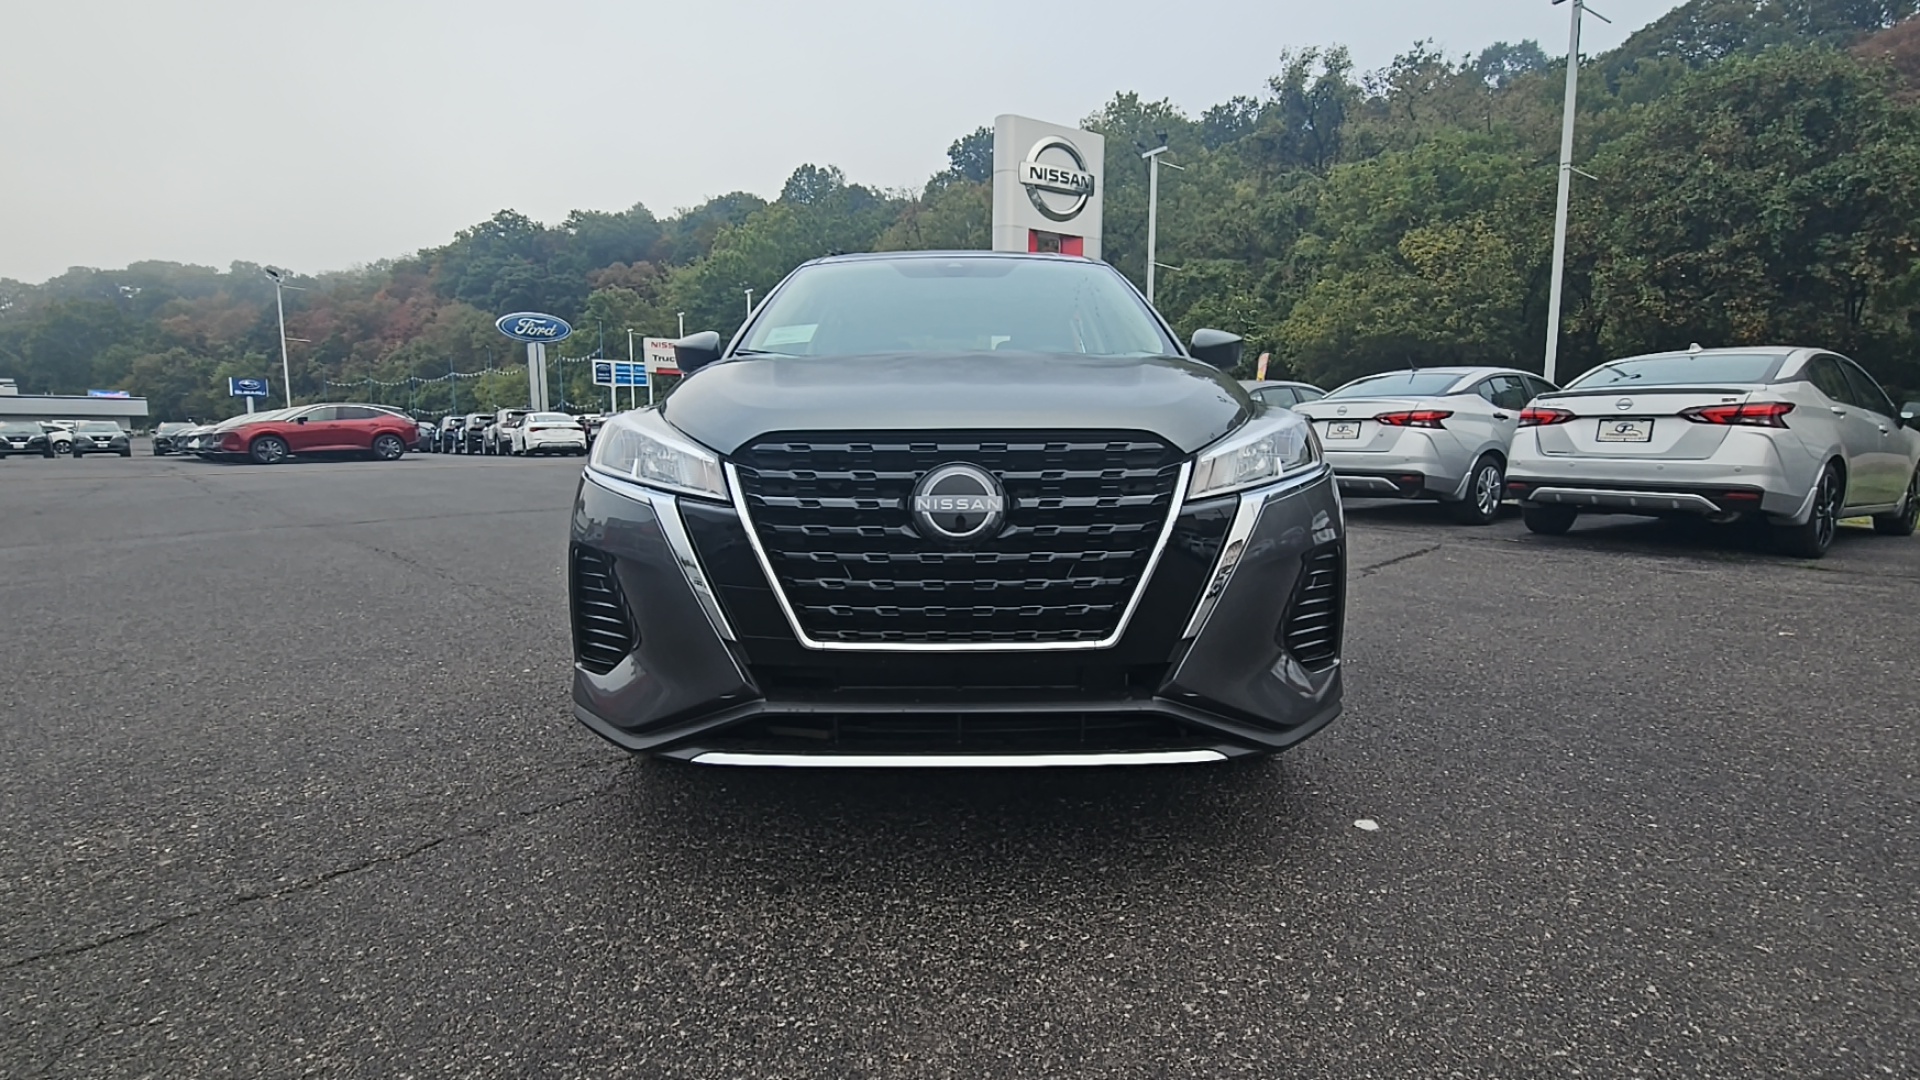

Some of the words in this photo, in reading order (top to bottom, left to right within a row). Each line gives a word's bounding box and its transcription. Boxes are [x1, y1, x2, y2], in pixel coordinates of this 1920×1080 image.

[1030, 166, 1089, 189] NISSAN
[514, 318, 557, 336] Ford
[651, 341, 674, 349] NISS
[652, 354, 675, 362] Truc
[917, 498, 1001, 510] NISSAN
